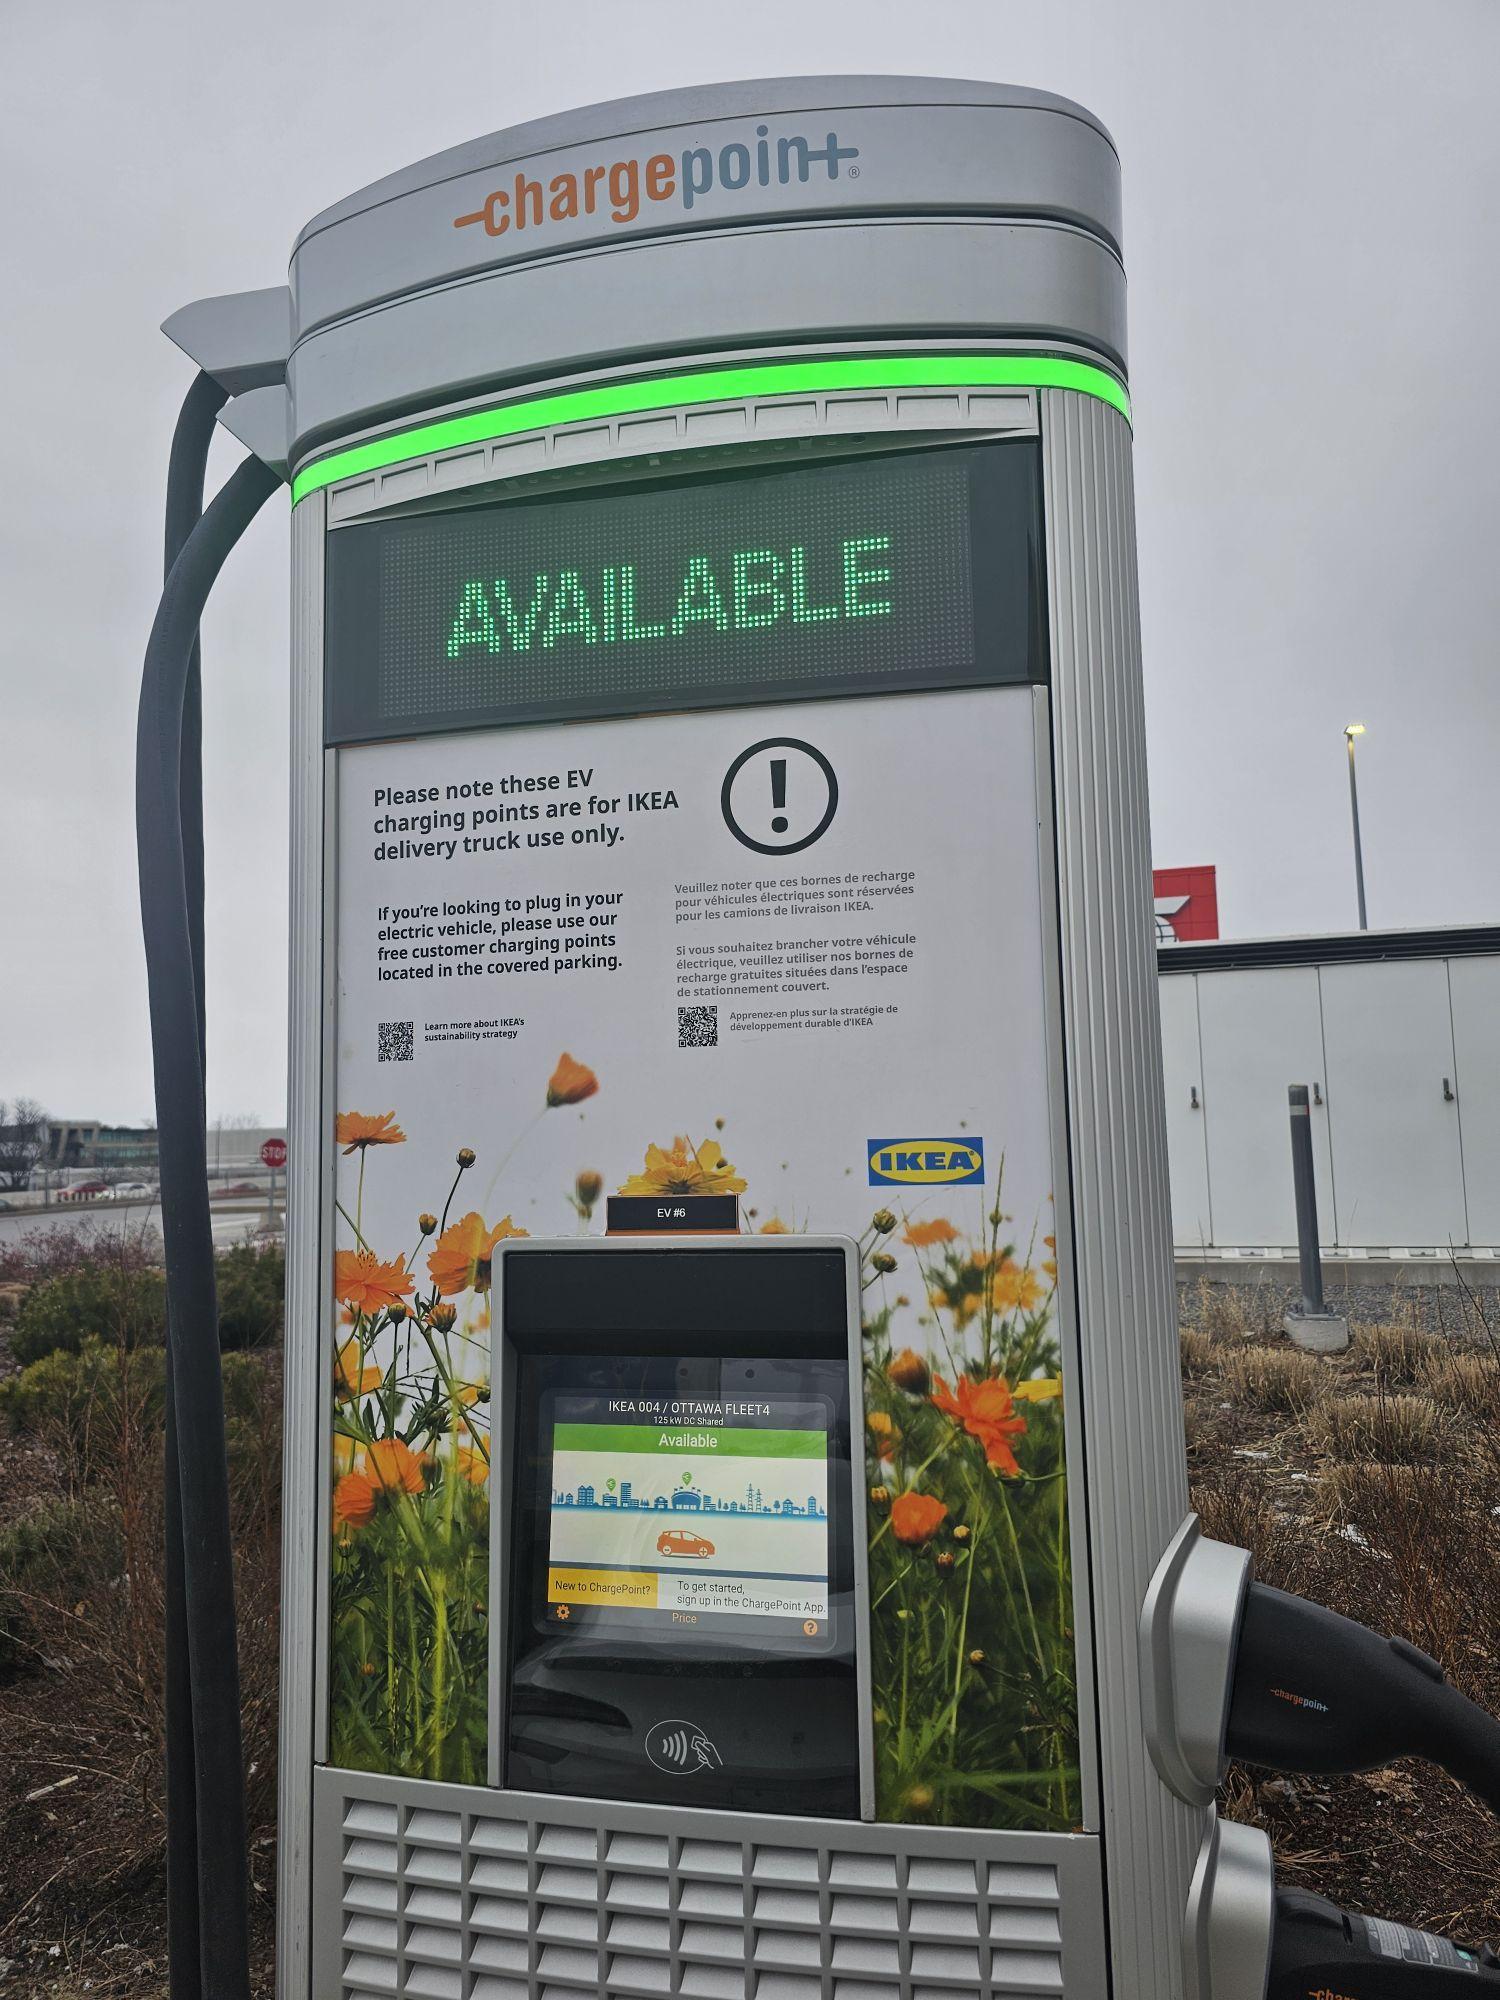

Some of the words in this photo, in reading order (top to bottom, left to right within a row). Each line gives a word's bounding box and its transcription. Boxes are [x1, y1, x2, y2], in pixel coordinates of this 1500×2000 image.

[447, 536, 891, 657] AVAILABLE
[374, 787, 439, 806] Please
[446, 779, 493, 799] note
[500, 772, 560, 795] these
[567, 769, 594, 788] EV
[374, 810, 465, 834] charging
[472, 803, 540, 830] points
[546, 800, 582, 817] are
[588, 796, 620, 815] for
[628, 790, 679, 812] IKEA
[374, 839, 457, 860] delivery
[463, 831, 520, 853] truck
[527, 830, 564, 847] use
[571, 823, 625, 847] only.
[675, 882, 718, 894] Veuillez
[721, 881, 752, 891] noter
[755, 880, 777, 892] que
[780, 878, 798, 888] ces
[801, 875, 841, 886] bornes
[844, 873, 858, 884] de
[862, 871, 915, 883] recharge
[378, 907, 388, 920] If
[443, 900, 500, 916] looking
[505, 899, 521, 911] to
[526, 895, 561, 914] plug
[566, 893, 581, 907] in
[585, 892, 623, 910] your
[675, 899, 701, 910] pour
[704, 893, 757, 906] véhicules
[760, 889, 825, 906] électriques
[828, 888, 854, 899] sont
[857, 884, 914, 897] réservées
[675, 912, 701, 924] pour
[705, 909, 720, 920] les
[723, 907, 771, 919] camions
[774, 905, 788, 916] de
[791, 903, 841, 915] livraison
[845, 901, 874, 912] IKEA.
[378, 924, 434, 940] electric
[438, 920, 496, 936] vehicle,
[501, 915, 552, 936] please
[557, 915, 584, 928] use
[589, 913, 617, 926] our
[378, 947, 408, 961] free
[412, 942, 485, 958] customer
[489, 936, 559, 955] charging
[565, 933, 616, 952] points
[676, 946, 686, 955] Si
[689, 945, 715, 954] vous
[718, 941, 773, 953] souhaitez
[776, 938, 828, 950] brancher
[832, 938, 862, 948] votre
[866, 934, 916, 946] véhicule
[378, 964, 434, 980] located
[439, 964, 452, 977] in
[457, 961, 483, 975] the
[487, 957, 549, 974] covered
[554, 954, 622, 973] parking.
[676, 958, 737, 971] électrique,
[740, 954, 783, 966] veuillez
[786, 953, 827, 964] utiliser
[830, 952, 851, 962] nos
[855, 949, 896, 960] bornes
[899, 948, 913, 958] de
[677, 972, 726, 984] recharge
[730, 968, 782, 983] gratuites
[786, 966, 827, 978] situées
[830, 965, 858, 976] dans
[677, 987, 690, 997] de
[693, 982, 778, 996] stationnement
[782, 981, 829, 992] couvert.
[730, 1010, 787, 1020] Apprenez-en
[791, 1008, 810, 1019] plus
[812, 1008, 827, 1017] sur
[830, 1007, 838, 1016] la
[841, 1006, 884, 1017] stratégie
[886, 1005, 898, 1013] de
[425, 1023, 448, 1031] Learn
[450, 1021, 471, 1029] more
[473, 1019, 498, 1028] about
[730, 1021, 802, 1032] développement
[805, 1019, 841, 1028] durable
[424, 1030, 480, 1041] sustainability
[482, 1029, 517, 1040] strategy
[880, 1152, 974, 1170] IKEA
[658, 1208, 671, 1217] EV
[673, 1208, 686, 1217] #6
[609, 1401, 635, 1412] IKEA
[639, 1402, 659, 1413] 004
[671, 1403, 722, 1414] OTTAWA
[725, 1404, 770, 1415] FLEET4
[654, 1416, 668, 1424] 125
[697, 1418, 723, 1426] Shared
[659, 1433, 718, 1448] Available
[555, 1581, 576, 1591] New
[578, 1582, 587, 1591] to
[590, 1582, 651, 1594] ChargePoint?
[677, 1581, 690, 1591] To
[692, 1583, 707, 1593] get
[709, 1582, 745, 1594] started,
[677, 1596, 697, 1606] sign
[699, 1598, 711, 1607] up
[713, 1597, 722, 1606] in
[724, 1597, 739, 1607] the
[742, 1598, 801, 1611] ChargePoint
[804, 1602, 826, 1614] App.
[672, 1613, 697, 1624] Price
